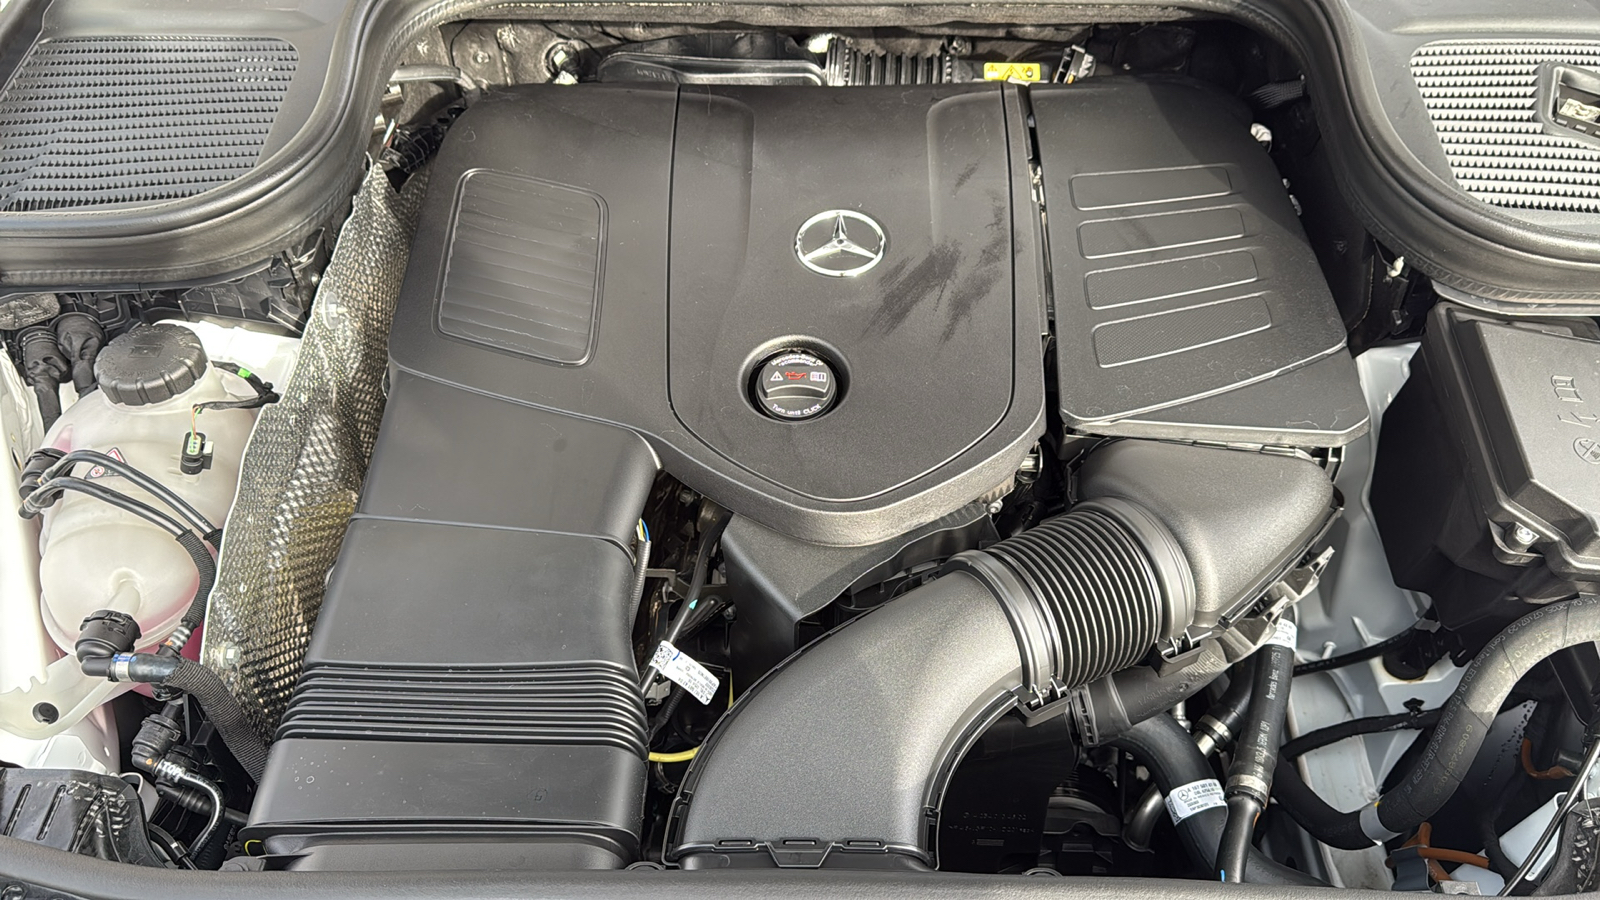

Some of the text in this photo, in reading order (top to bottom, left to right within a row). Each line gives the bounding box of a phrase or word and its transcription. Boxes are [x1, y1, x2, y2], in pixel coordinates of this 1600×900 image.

[771, 354, 816, 365] Mercedes-Benz
[772, 403, 785, 413] Turn
[803, 404, 821, 414] CLICK
